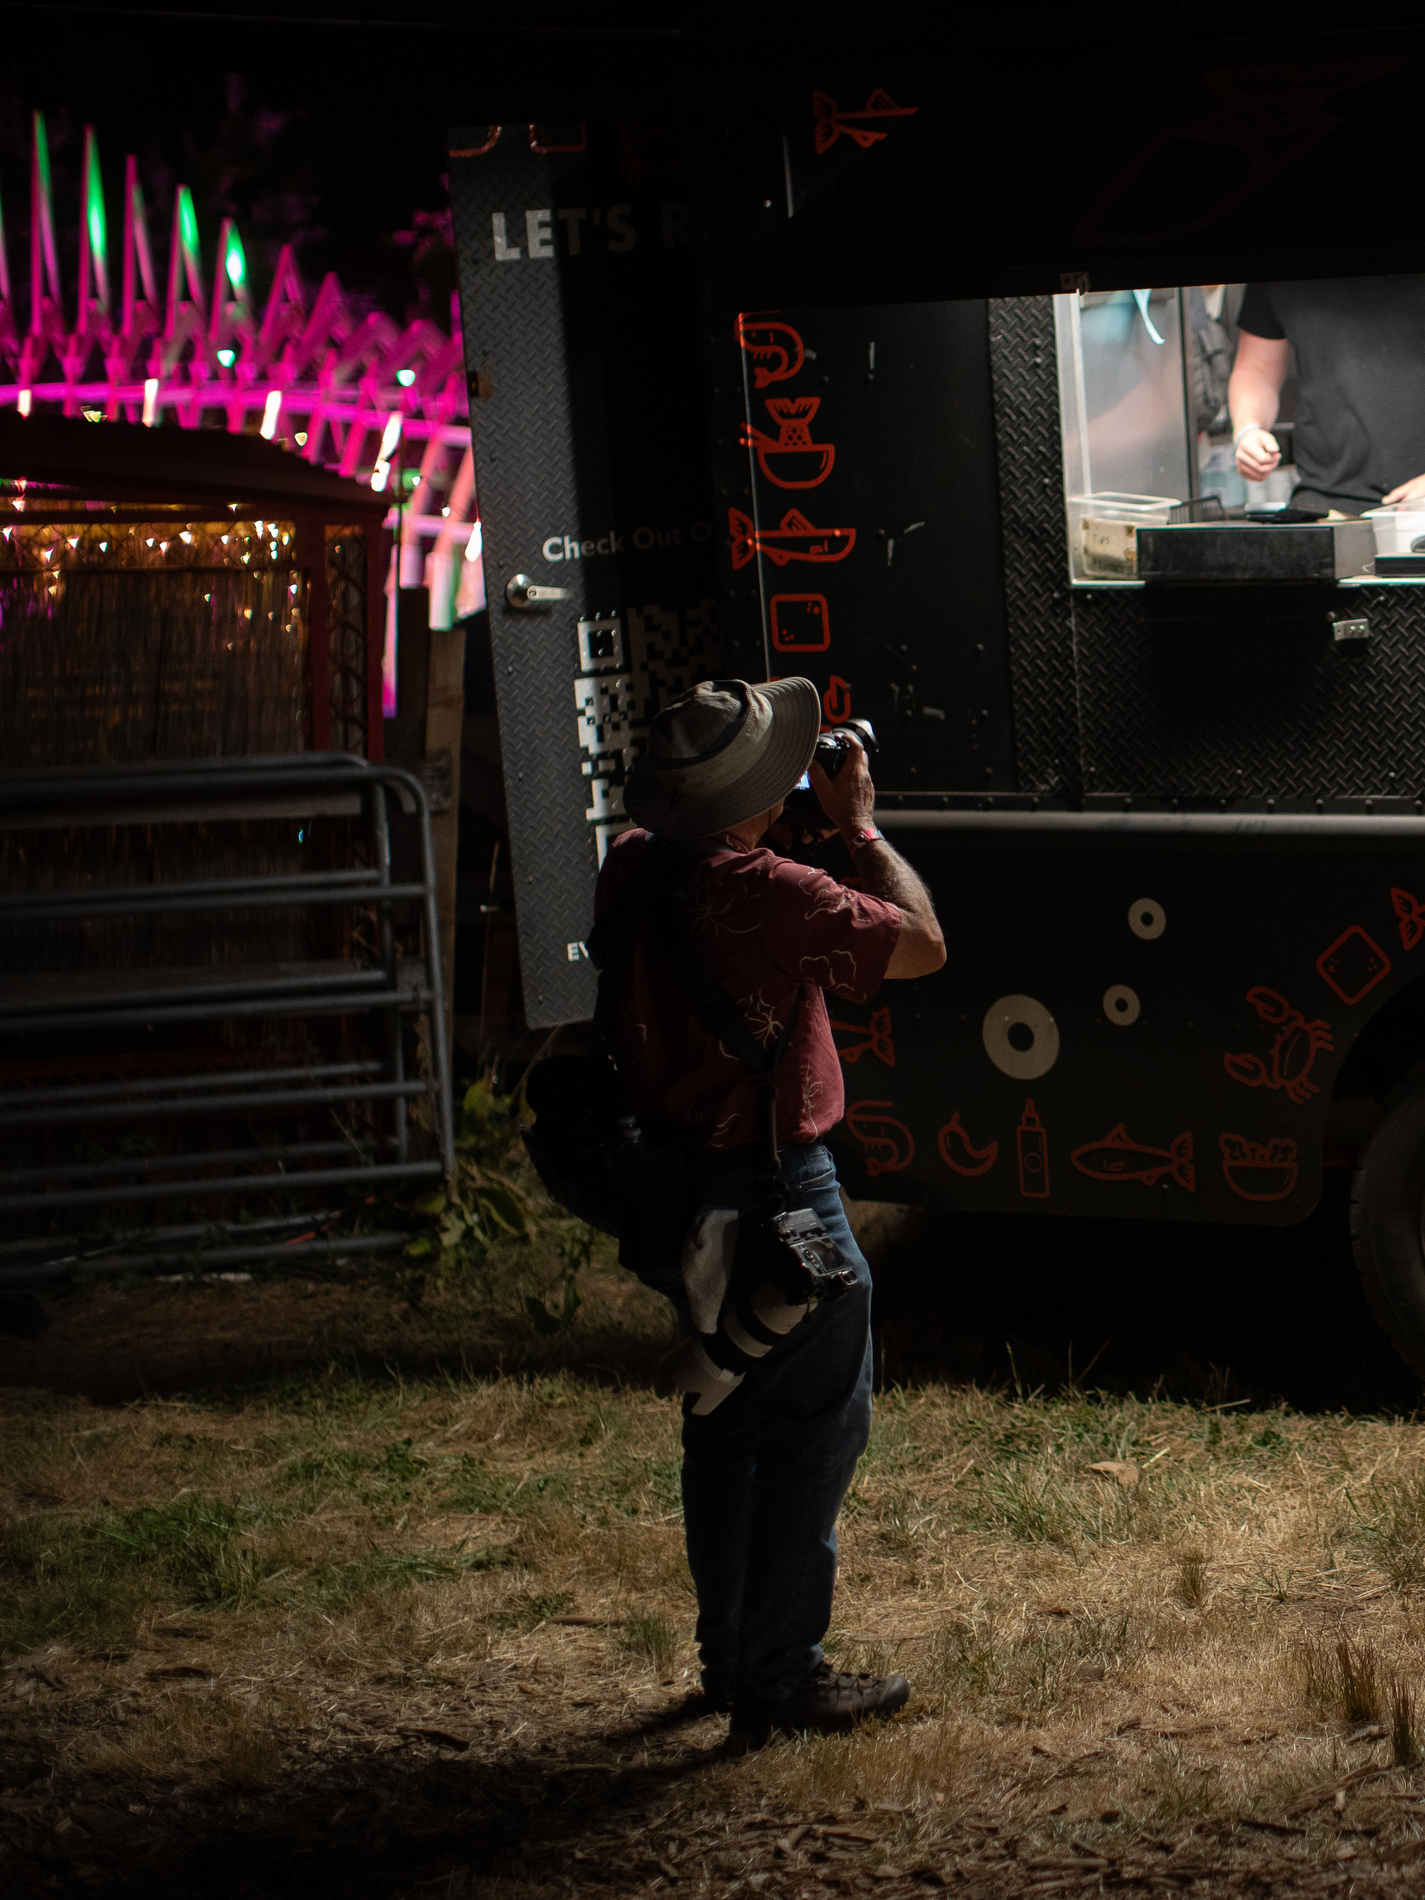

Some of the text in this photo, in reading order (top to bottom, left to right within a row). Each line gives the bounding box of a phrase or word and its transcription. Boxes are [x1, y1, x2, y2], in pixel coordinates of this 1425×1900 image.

[491, 203, 637, 261] LET'S
[542, 530, 625, 563] Check
[632, 525, 683, 550] Out
